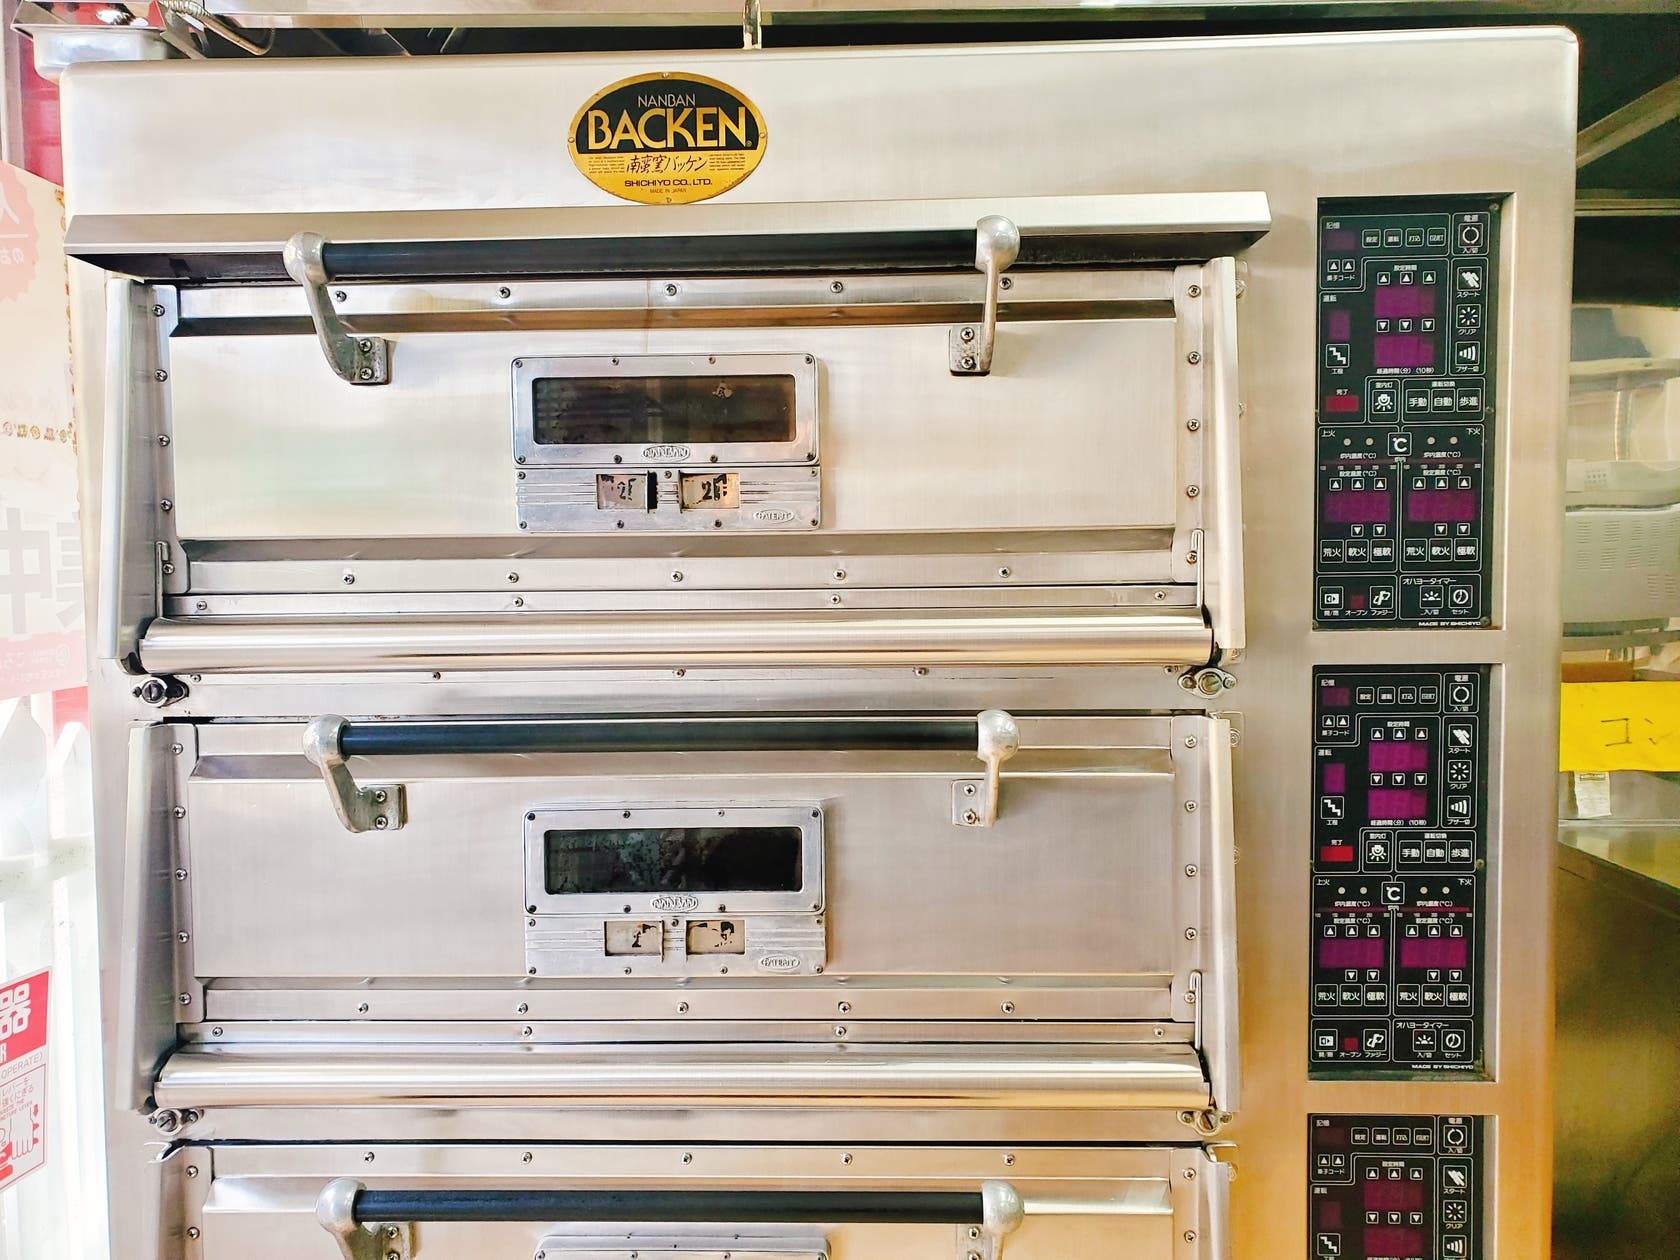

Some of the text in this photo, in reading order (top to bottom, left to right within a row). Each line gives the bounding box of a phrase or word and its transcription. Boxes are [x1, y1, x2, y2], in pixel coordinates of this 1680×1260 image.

[638, 94, 696, 107] NANBAN
[588, 107, 746, 150] BACKEN
[1409, 397, 1427, 407] 手動
[1434, 397, 1452, 406] 自動
[1459, 396, 1477, 406] 歩進
[1323, 547, 1341, 557] 荒火
[1348, 547, 1366, 557] 軟火
[1406, 547, 1425, 556] 荒火
[1432, 546, 1450, 556] 軟火
[1402, 848, 1419, 858] 手動
[1427, 848, 1444, 857] 自動
[1451, 848, 1469, 857] 歩進
[1458, 878, 1472, 886] 下火
[1318, 992, 1335, 1001] 荒火
[1342, 992, 1360, 1001] 軟火
[1400, 992, 1417, 1001] 荒火
[1424, 992, 1442, 1001] 軟火
